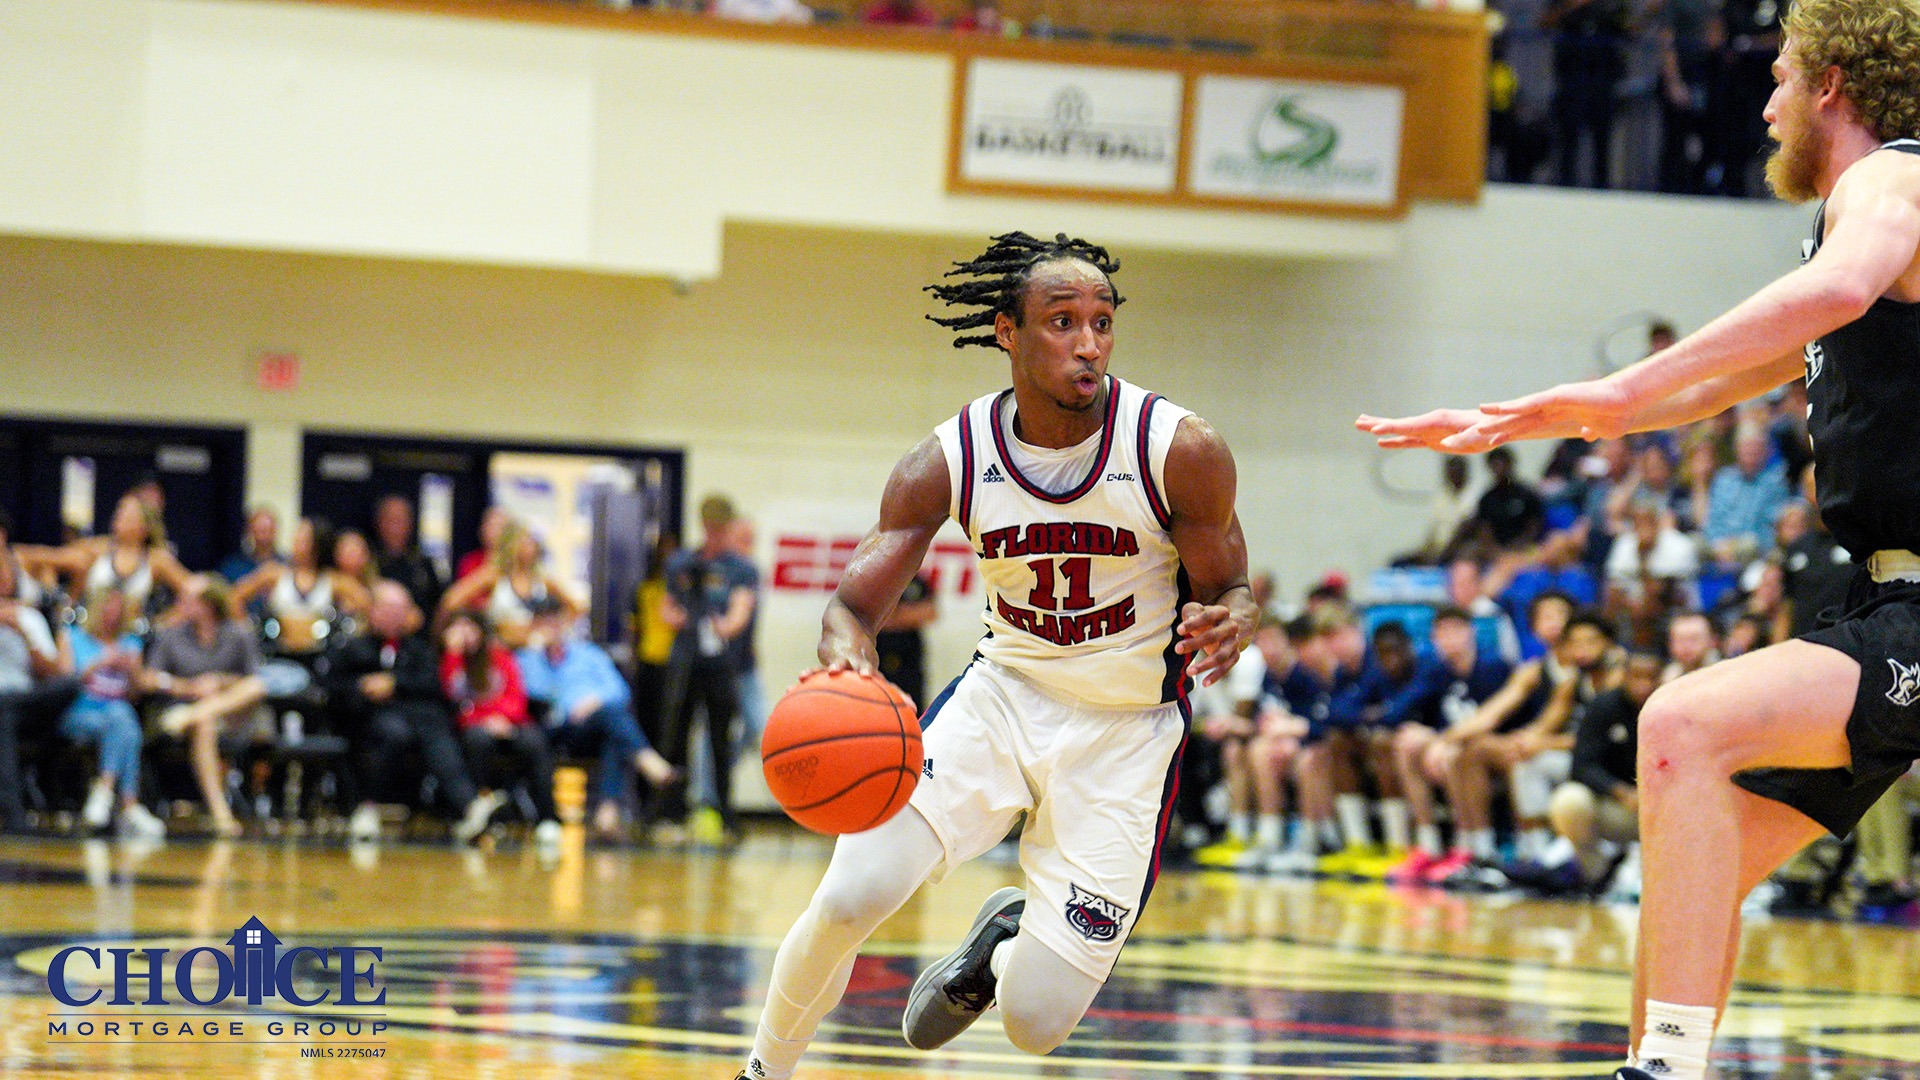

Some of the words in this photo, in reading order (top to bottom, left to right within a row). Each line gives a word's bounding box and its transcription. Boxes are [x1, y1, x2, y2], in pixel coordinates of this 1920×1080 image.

[981, 522, 1139, 559] FLORIDA
[1027, 557, 1095, 611] 11
[997, 592, 1136, 646] ATLANTIC
[1068, 884, 1129, 924] FAU
